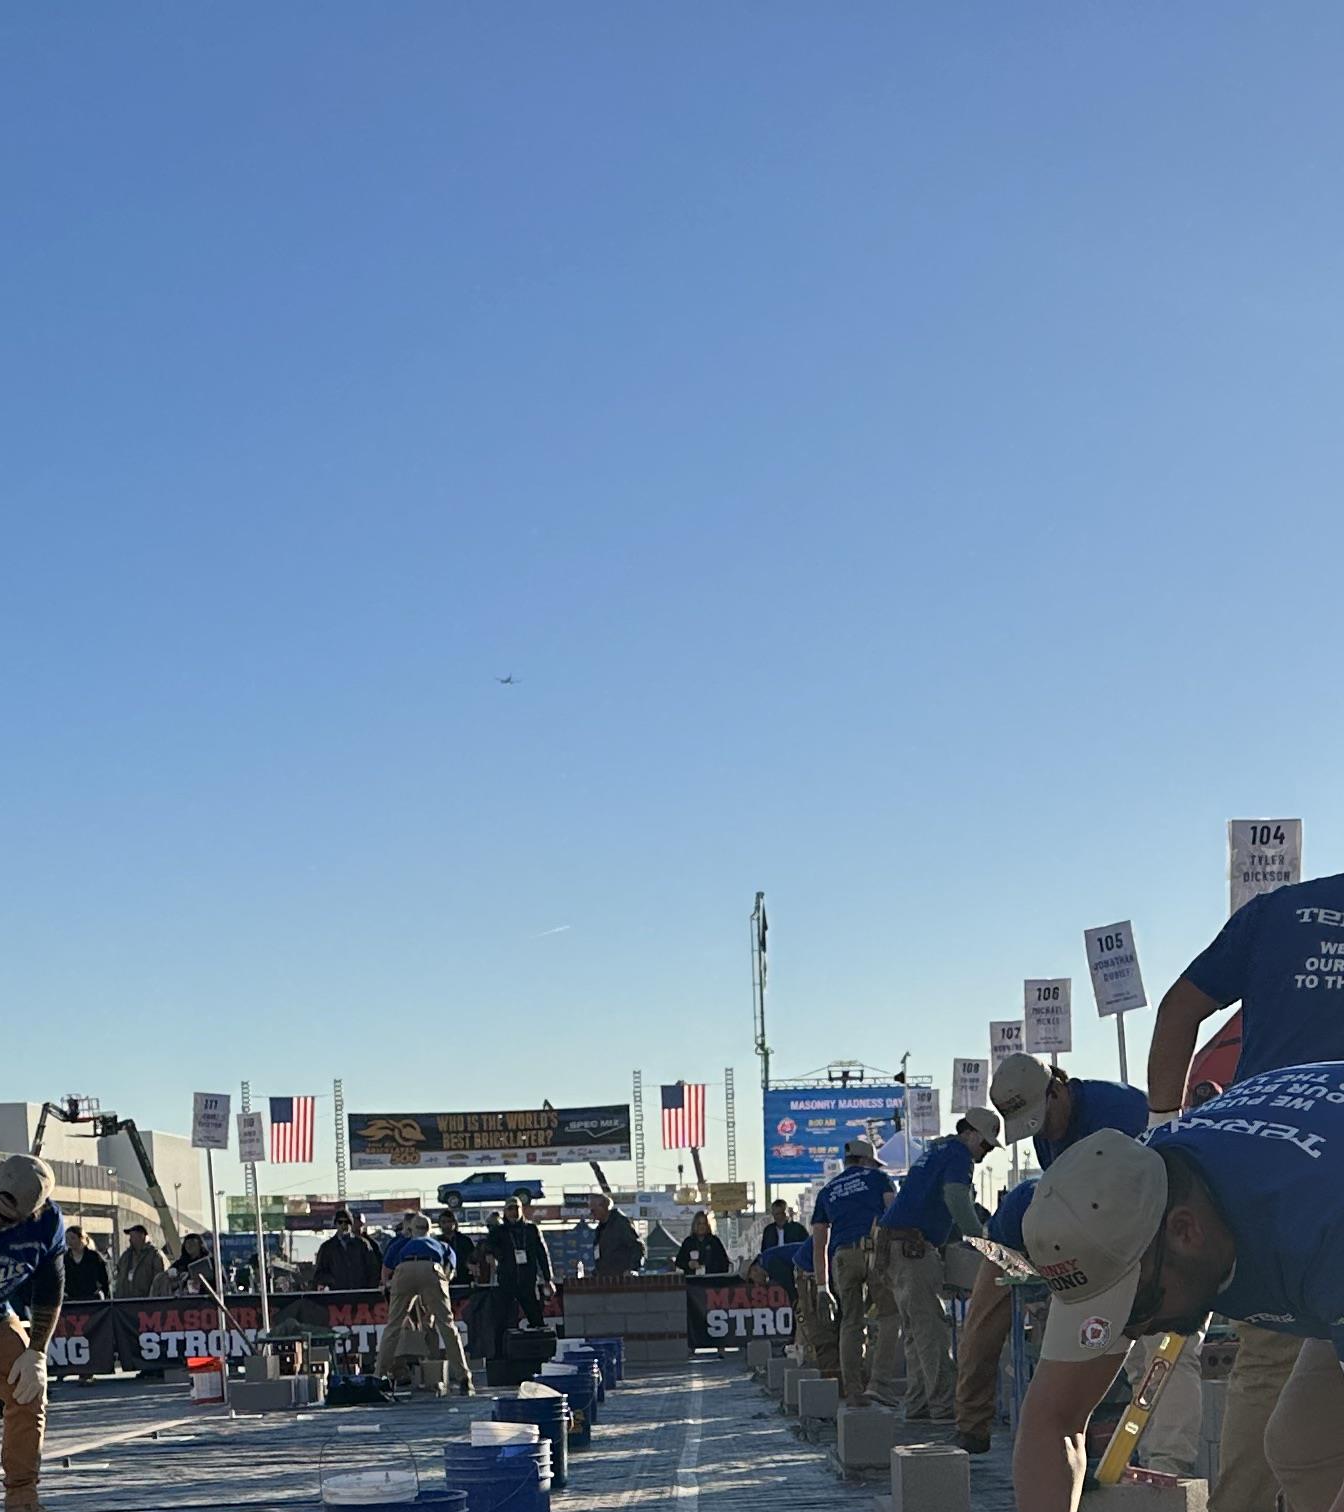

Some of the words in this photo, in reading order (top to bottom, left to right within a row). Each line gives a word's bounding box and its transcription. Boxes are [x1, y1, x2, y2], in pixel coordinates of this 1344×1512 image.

[1250, 825, 1285, 845] 104
[1250, 854, 1285, 866] TYLER
[1243, 870, 1290, 883] DICKSON
[1097, 932, 1123, 953] 105
[1305, 957, 1344, 972] OUR
[1294, 975, 1318, 989] TO
[1001, 1027, 1021, 1040] 107
[790, 1099, 836, 1110] MASONRY
[838, 1097, 884, 1109] MADNESS
[1269, 1096, 1316, 1112] WE
[436, 1115, 465, 1131] WHO
[468, 1114, 480, 1130] IS
[482, 1113, 503, 1130] THE
[507, 1111, 558, 1130] WORLD'S
[443, 1132, 471, 1149] BEST
[1047, 1270, 1089, 1292] ONG
[705, 1285, 790, 1309] MASO
[138, 1328, 268, 1360] STRON
